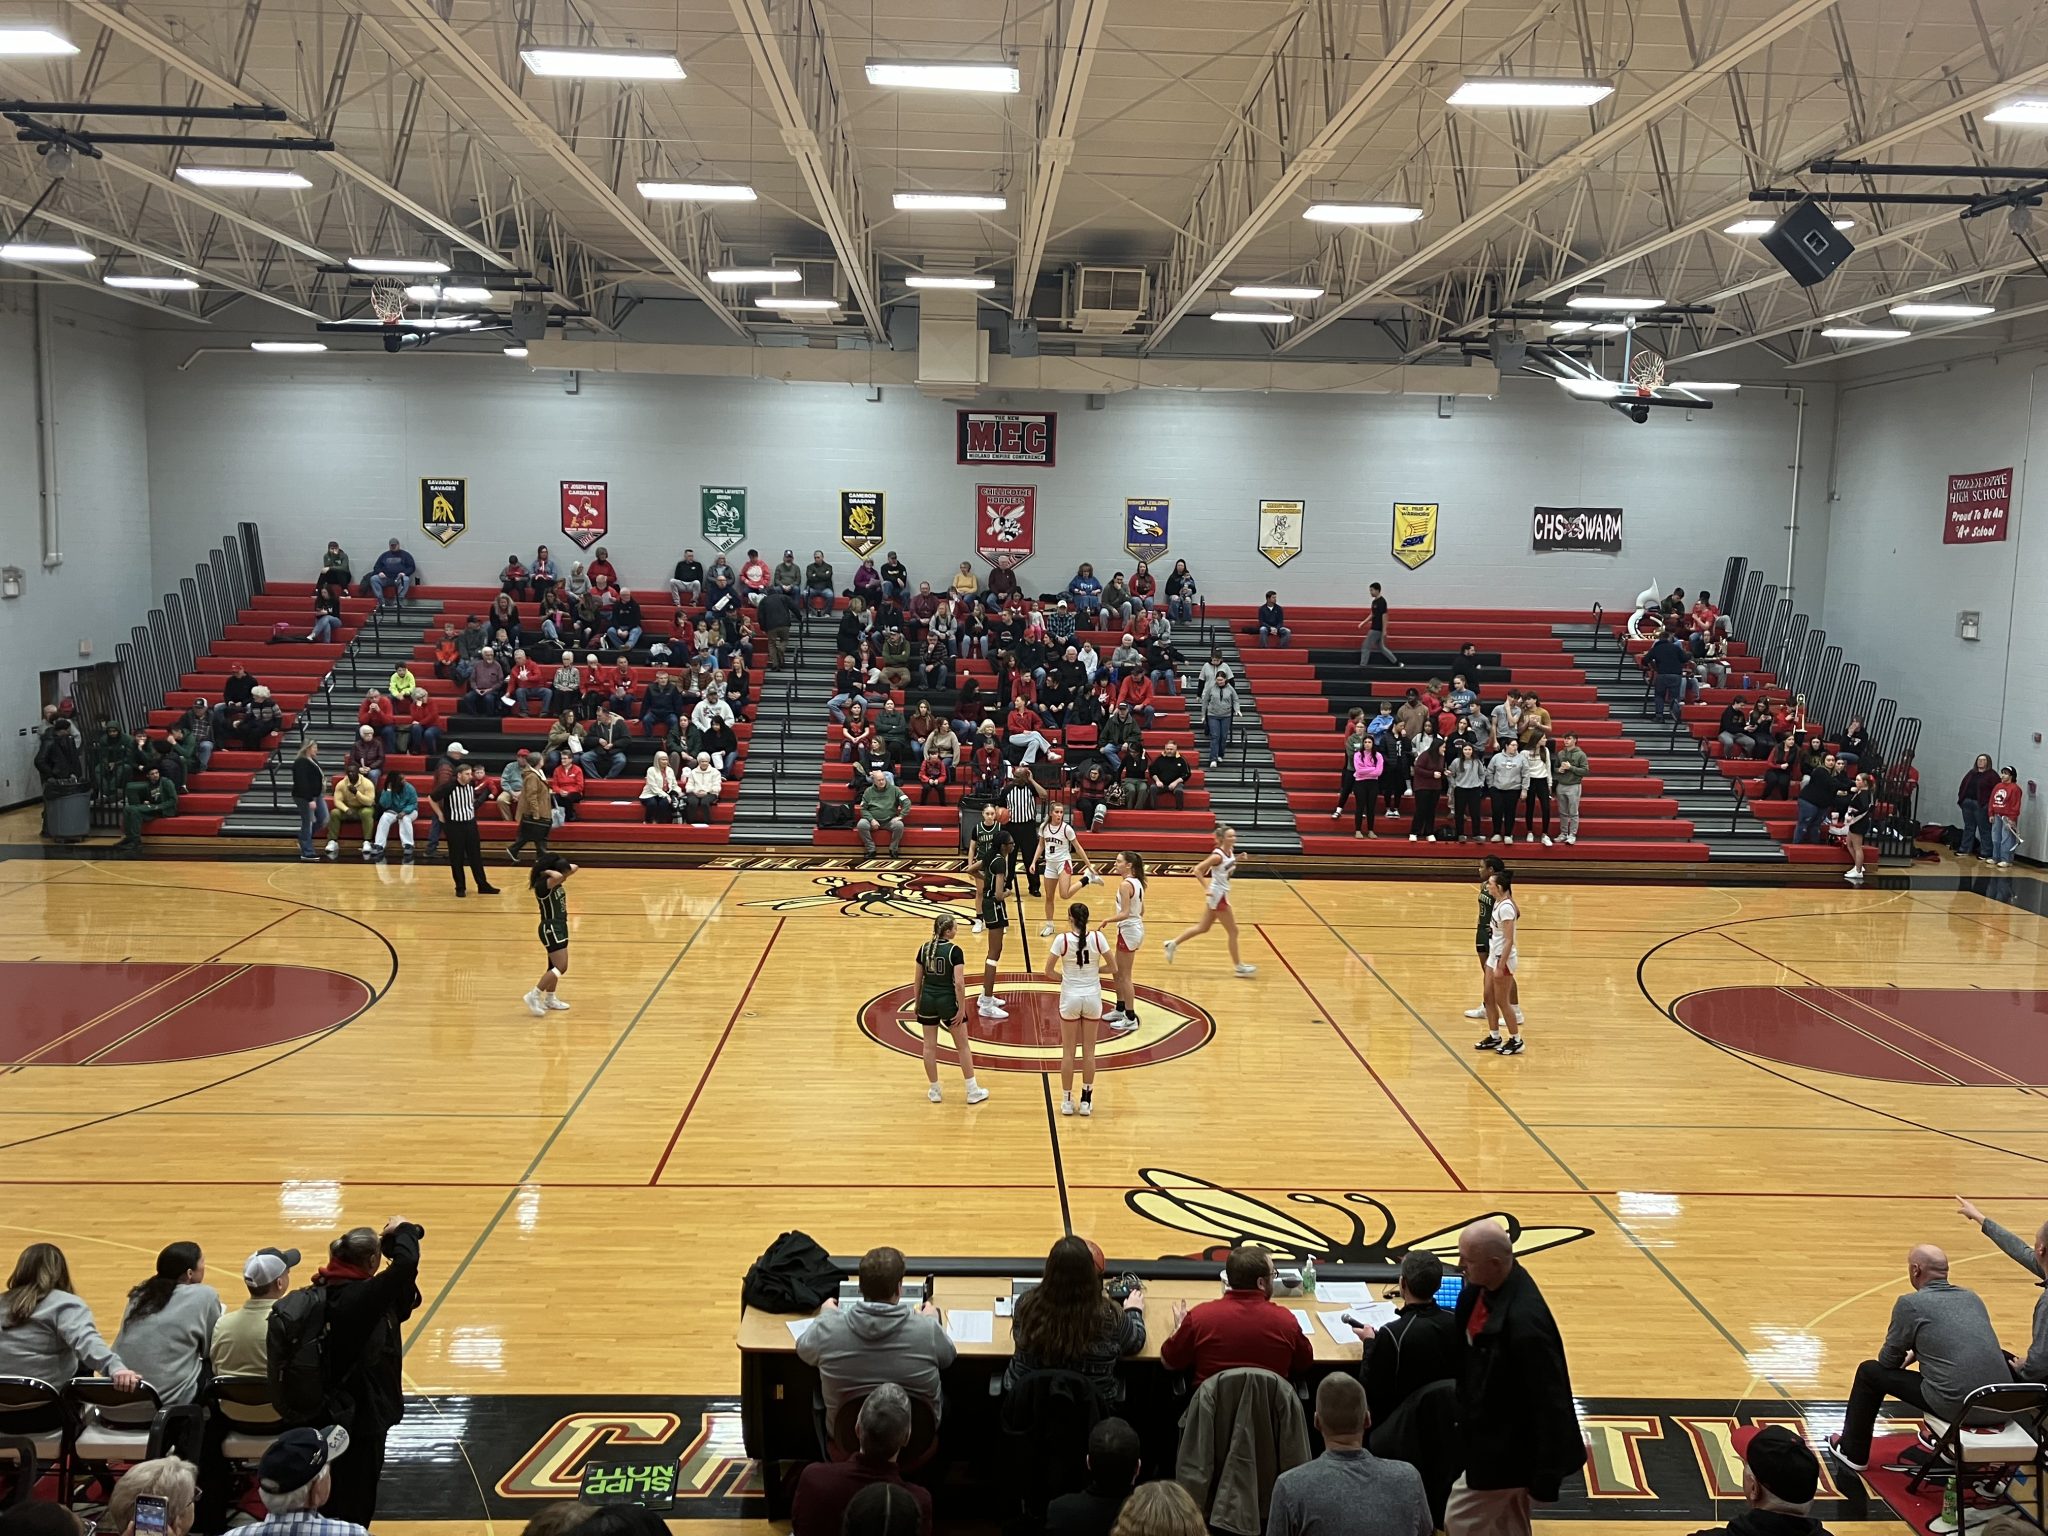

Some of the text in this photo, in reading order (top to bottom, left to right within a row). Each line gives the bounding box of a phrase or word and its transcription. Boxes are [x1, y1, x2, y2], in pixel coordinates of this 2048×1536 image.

[967, 421, 1046, 454] MEC
[1952, 474, 2007, 490] CHILLICOTHE
[981, 488, 1032, 496] CHILLICOTHE
[1949, 487, 2008, 504] HIGH SCHOOL
[1951, 510, 1974, 522] Proud
[1973, 509, 1981, 520] To
[1534, 513, 1622, 543] CHS SWARM
[1971, 525, 1996, 538] School
[1076, 949, 1090, 965] 11
[585, 1476, 672, 1495] SLIPP
